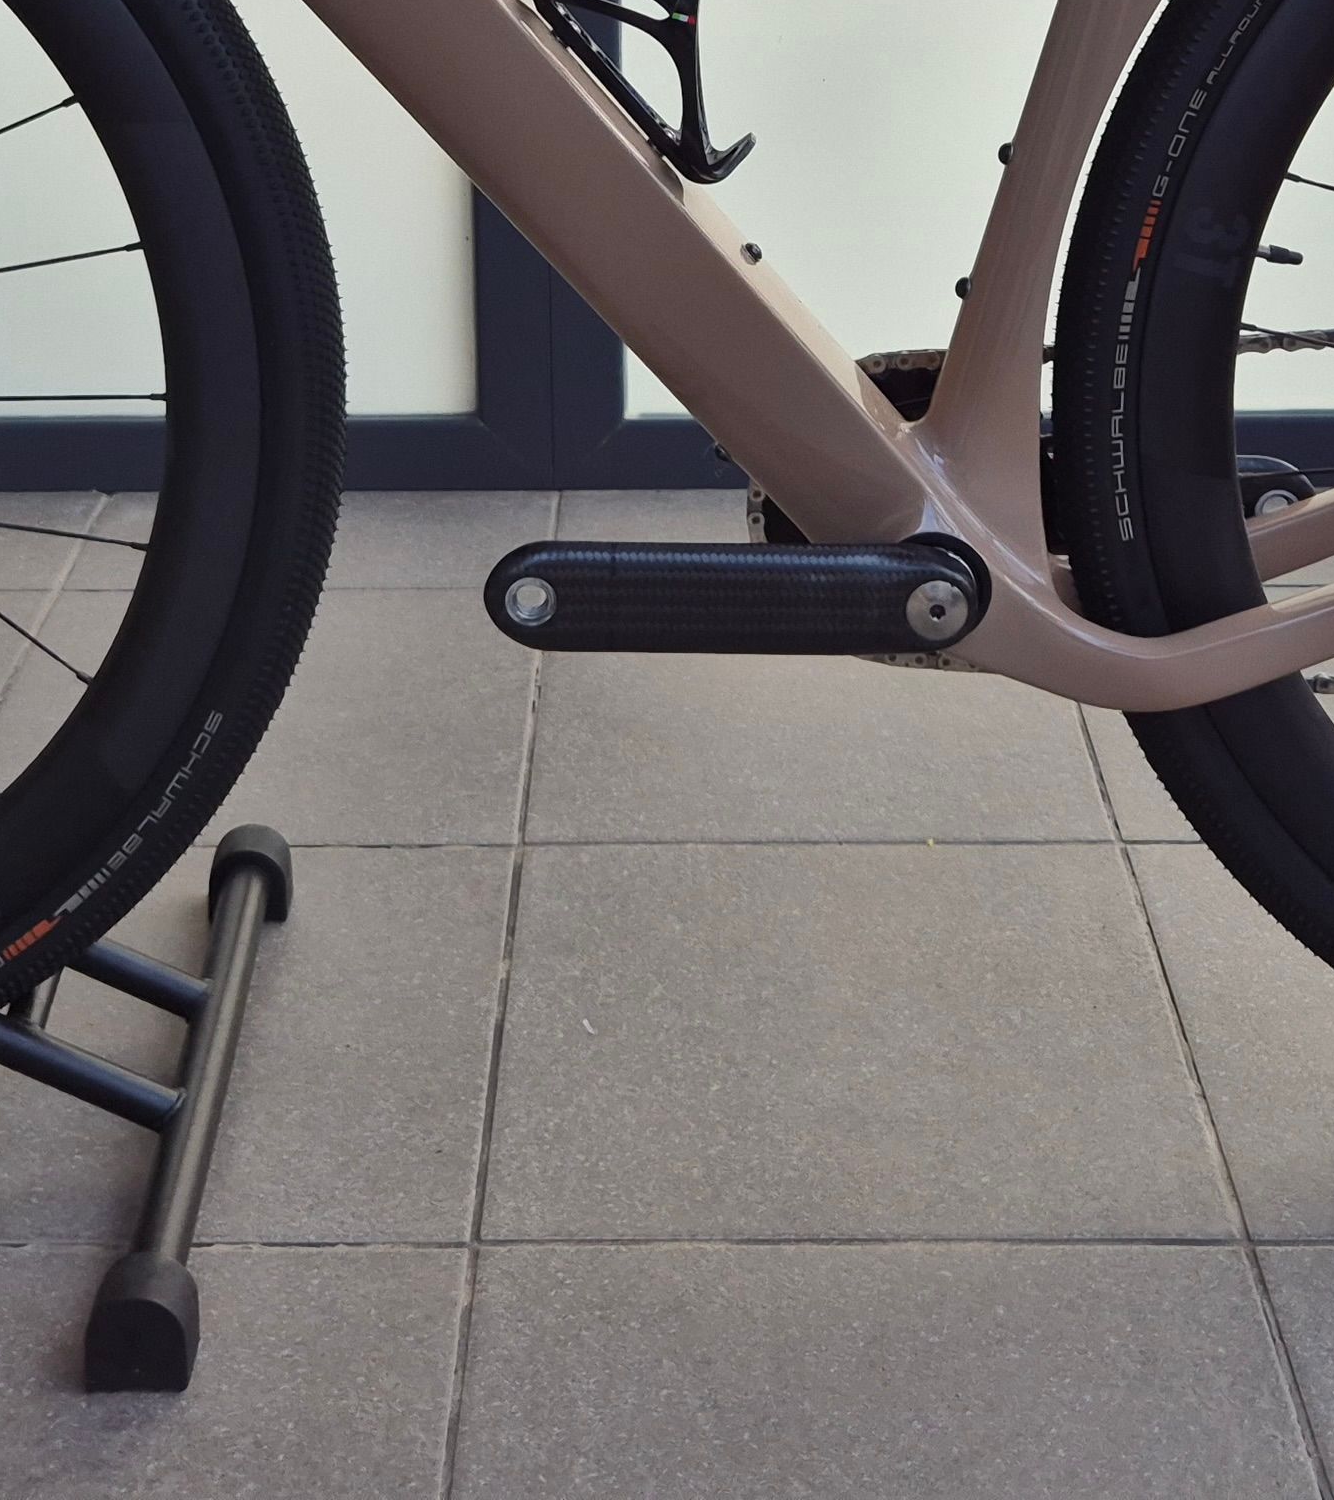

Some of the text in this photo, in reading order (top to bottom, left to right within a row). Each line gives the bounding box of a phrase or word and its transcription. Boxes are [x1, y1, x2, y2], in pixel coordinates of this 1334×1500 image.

[1111, 343, 1134, 542] SCHWALBE
[1152, 88, 1208, 198] G-ONE
[107, 710, 223, 870] SCHWALBE
